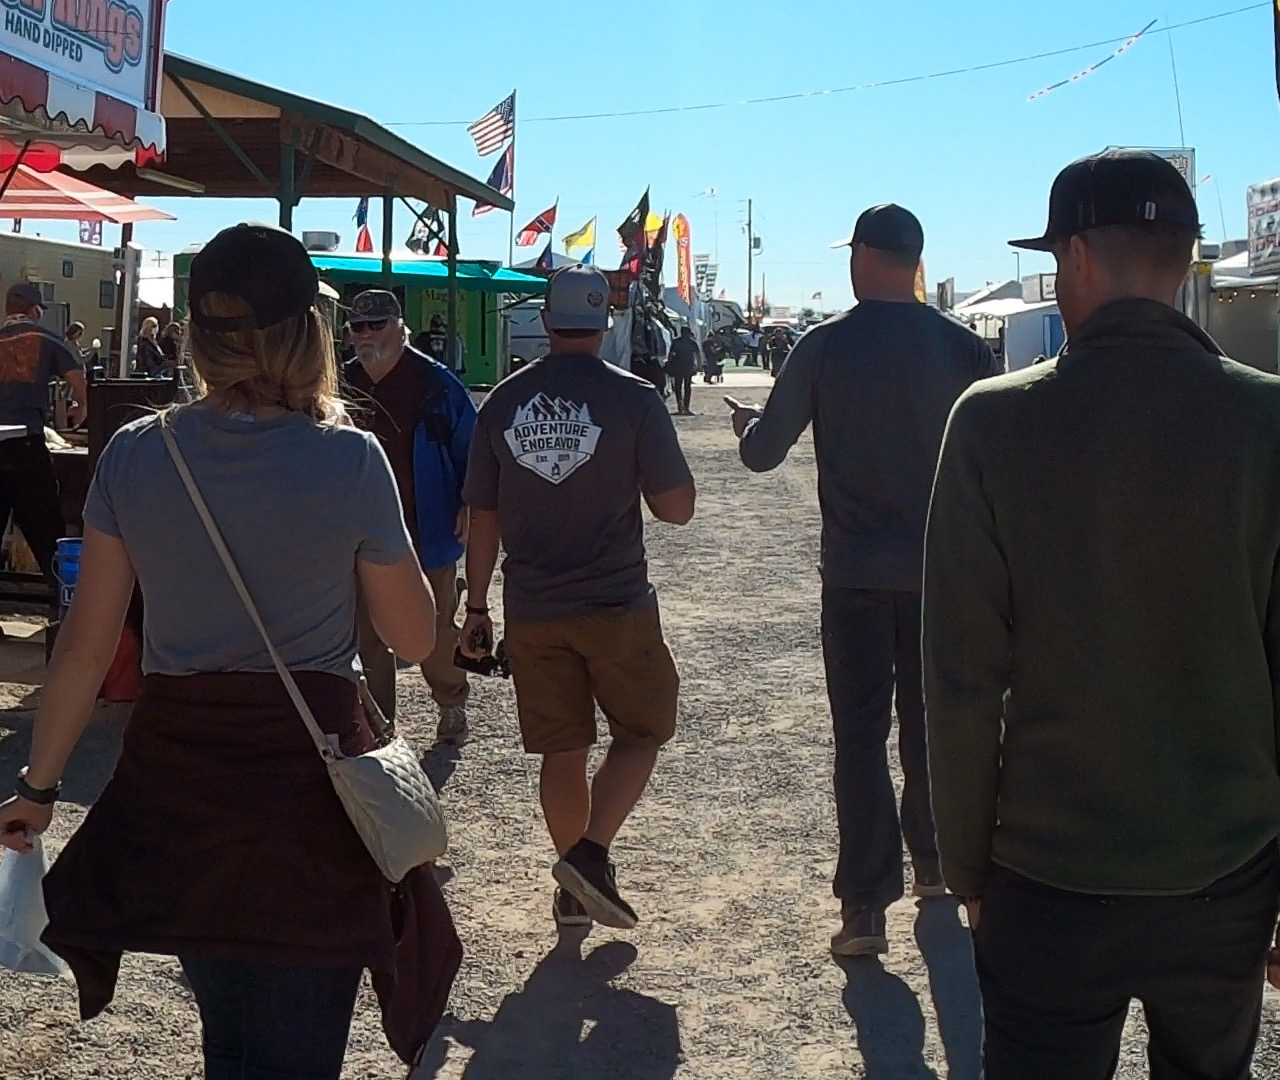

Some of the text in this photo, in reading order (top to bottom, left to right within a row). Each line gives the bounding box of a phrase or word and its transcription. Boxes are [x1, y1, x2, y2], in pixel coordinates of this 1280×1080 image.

[4, 10, 83, 63] HAND DIPPED
[513, 423, 589, 441] ADVENTURE
[520, 437, 581, 453] ENDEAVOR
